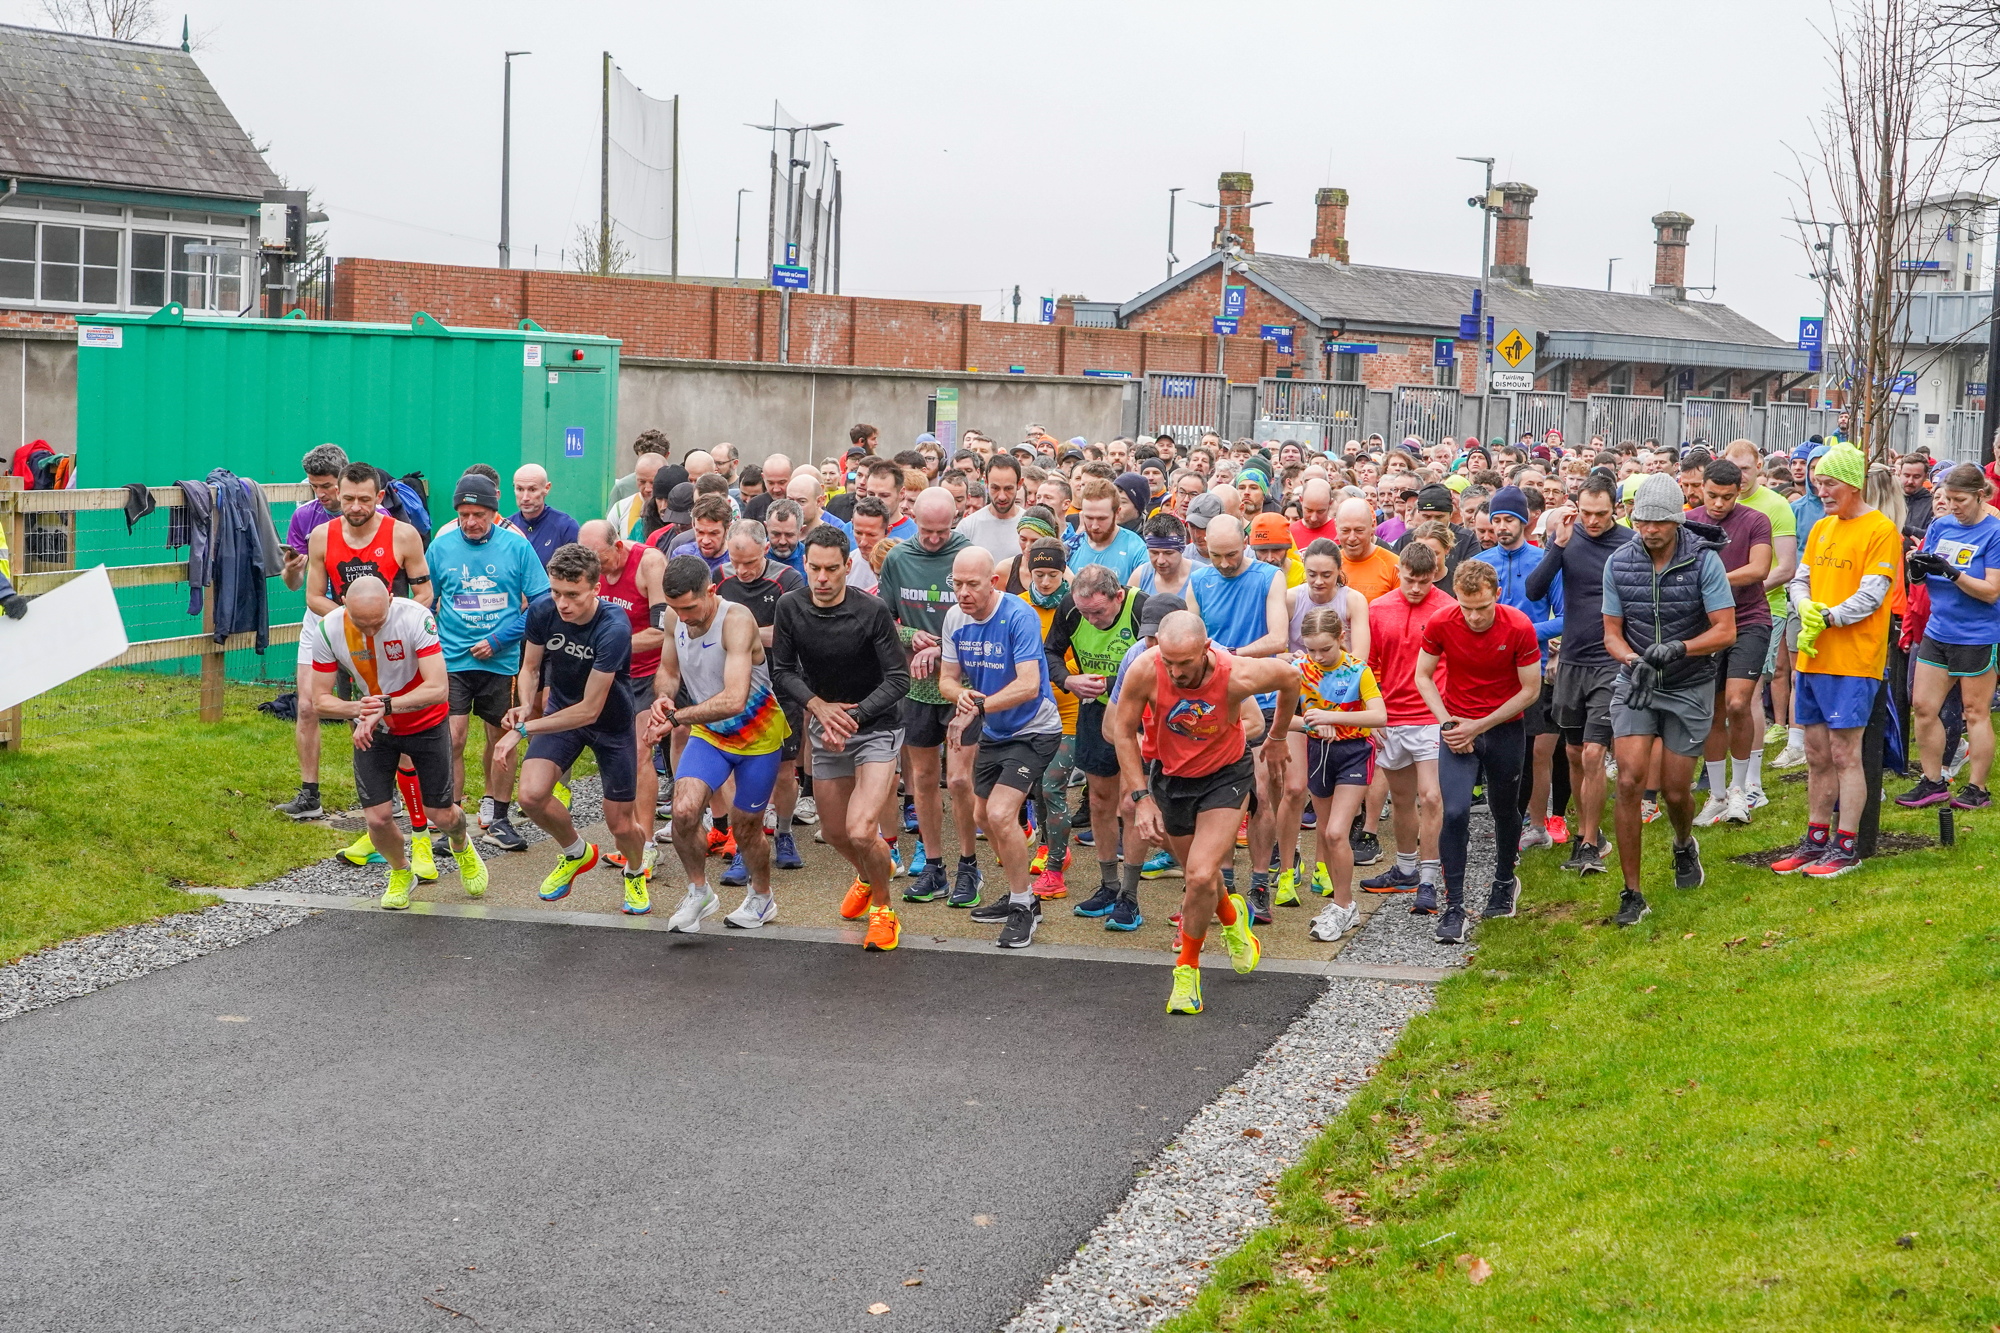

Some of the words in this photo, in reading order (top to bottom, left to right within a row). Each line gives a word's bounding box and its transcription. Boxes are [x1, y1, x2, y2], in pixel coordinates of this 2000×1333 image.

[1442, 346, 1446, 355] 1
[900, 584, 958, 602] IRONMAN
[612, 596, 634, 610] CORK
[462, 614, 484, 622] Fingal
